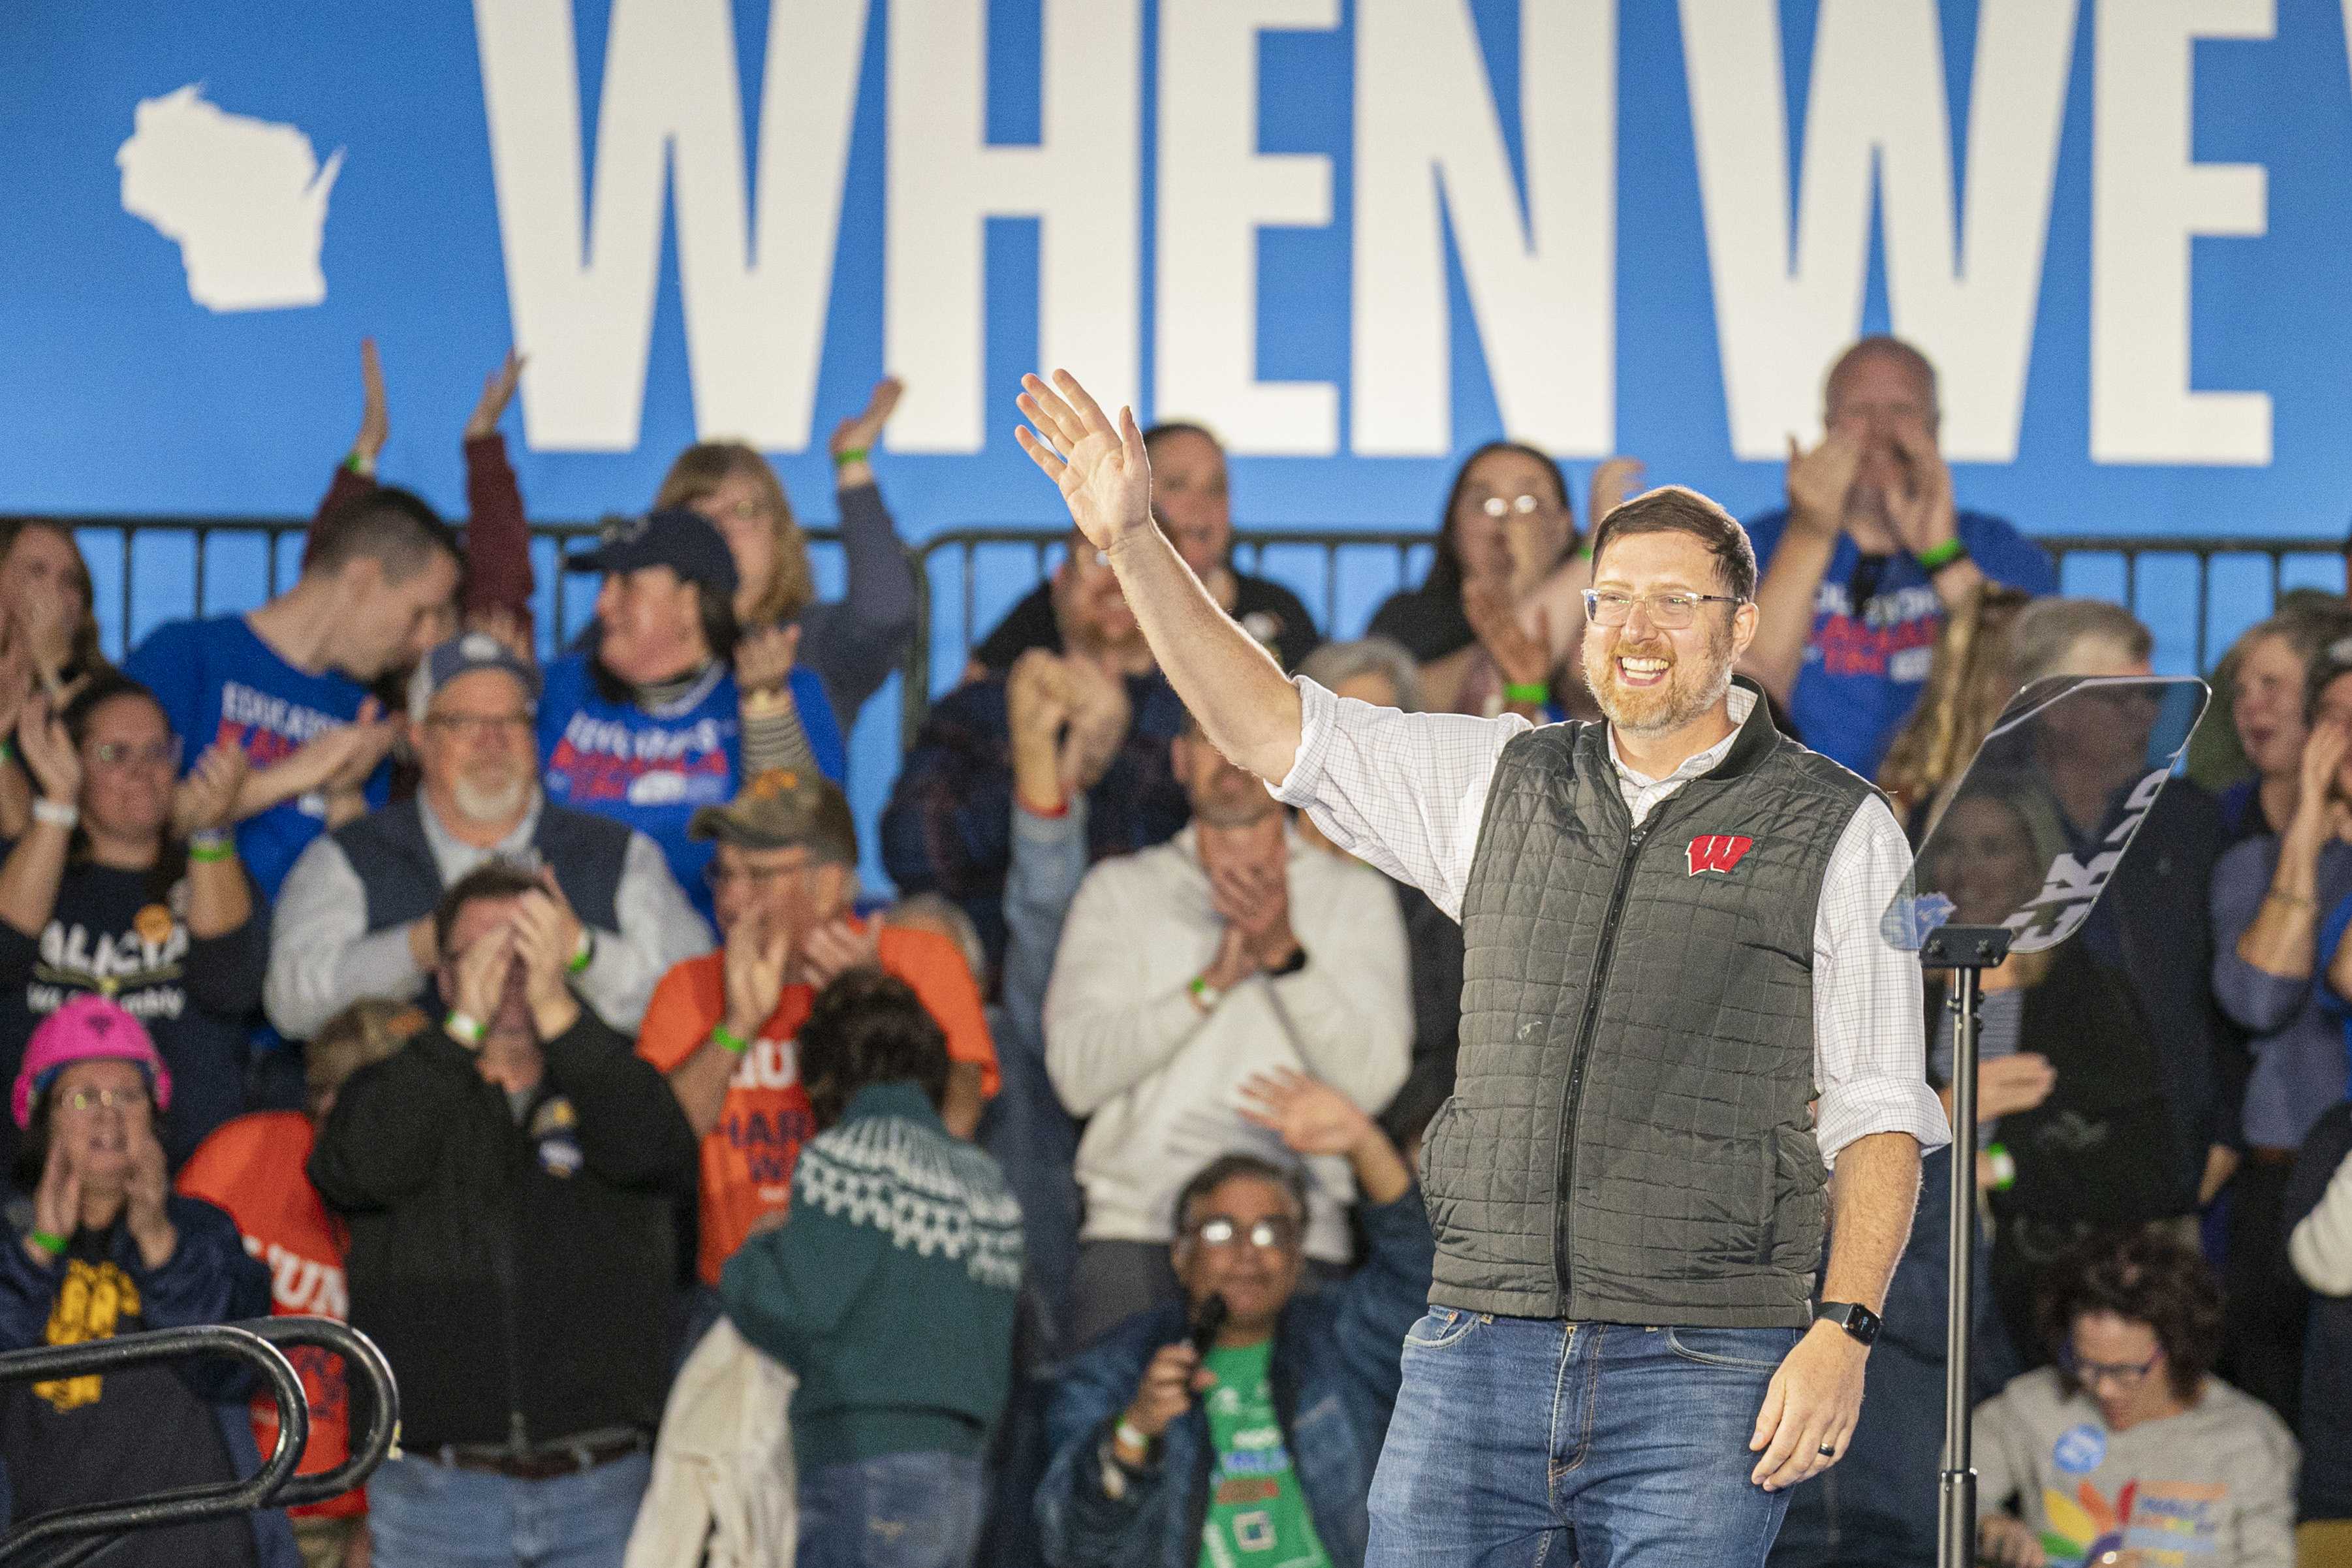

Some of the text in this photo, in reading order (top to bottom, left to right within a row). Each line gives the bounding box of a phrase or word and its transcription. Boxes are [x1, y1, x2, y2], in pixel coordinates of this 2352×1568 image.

[473, 0, 2276, 466] WHEN WE
[1684, 834, 1754, 877] W
